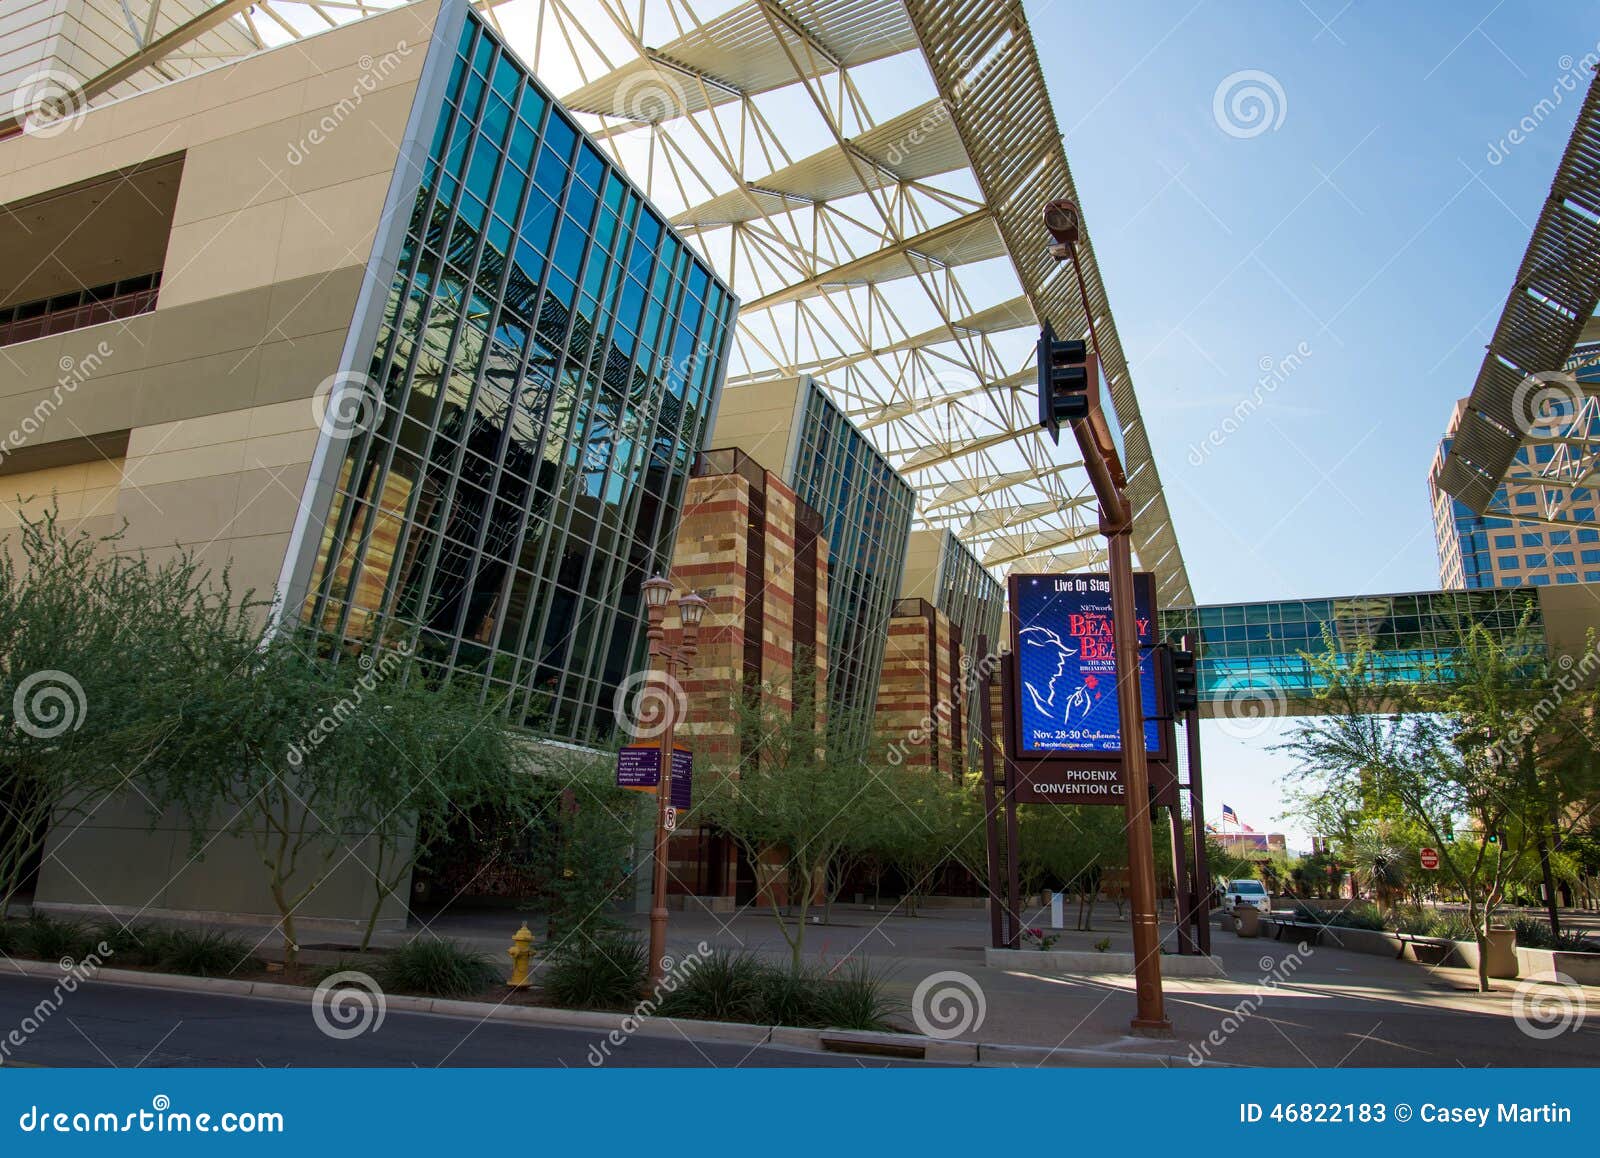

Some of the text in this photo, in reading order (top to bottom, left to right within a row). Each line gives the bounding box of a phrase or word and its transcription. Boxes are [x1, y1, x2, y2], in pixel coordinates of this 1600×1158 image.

[1055, 579, 1110, 593] Live On Stag
[1068, 614, 1149, 636] BEAY
[1033, 730, 1053, 739] Nov.
[1055, 730, 1080, 739] 28-30
[1067, 770, 1117, 780] PHOENIX
[1033, 784, 1107, 794] CONVENTION
